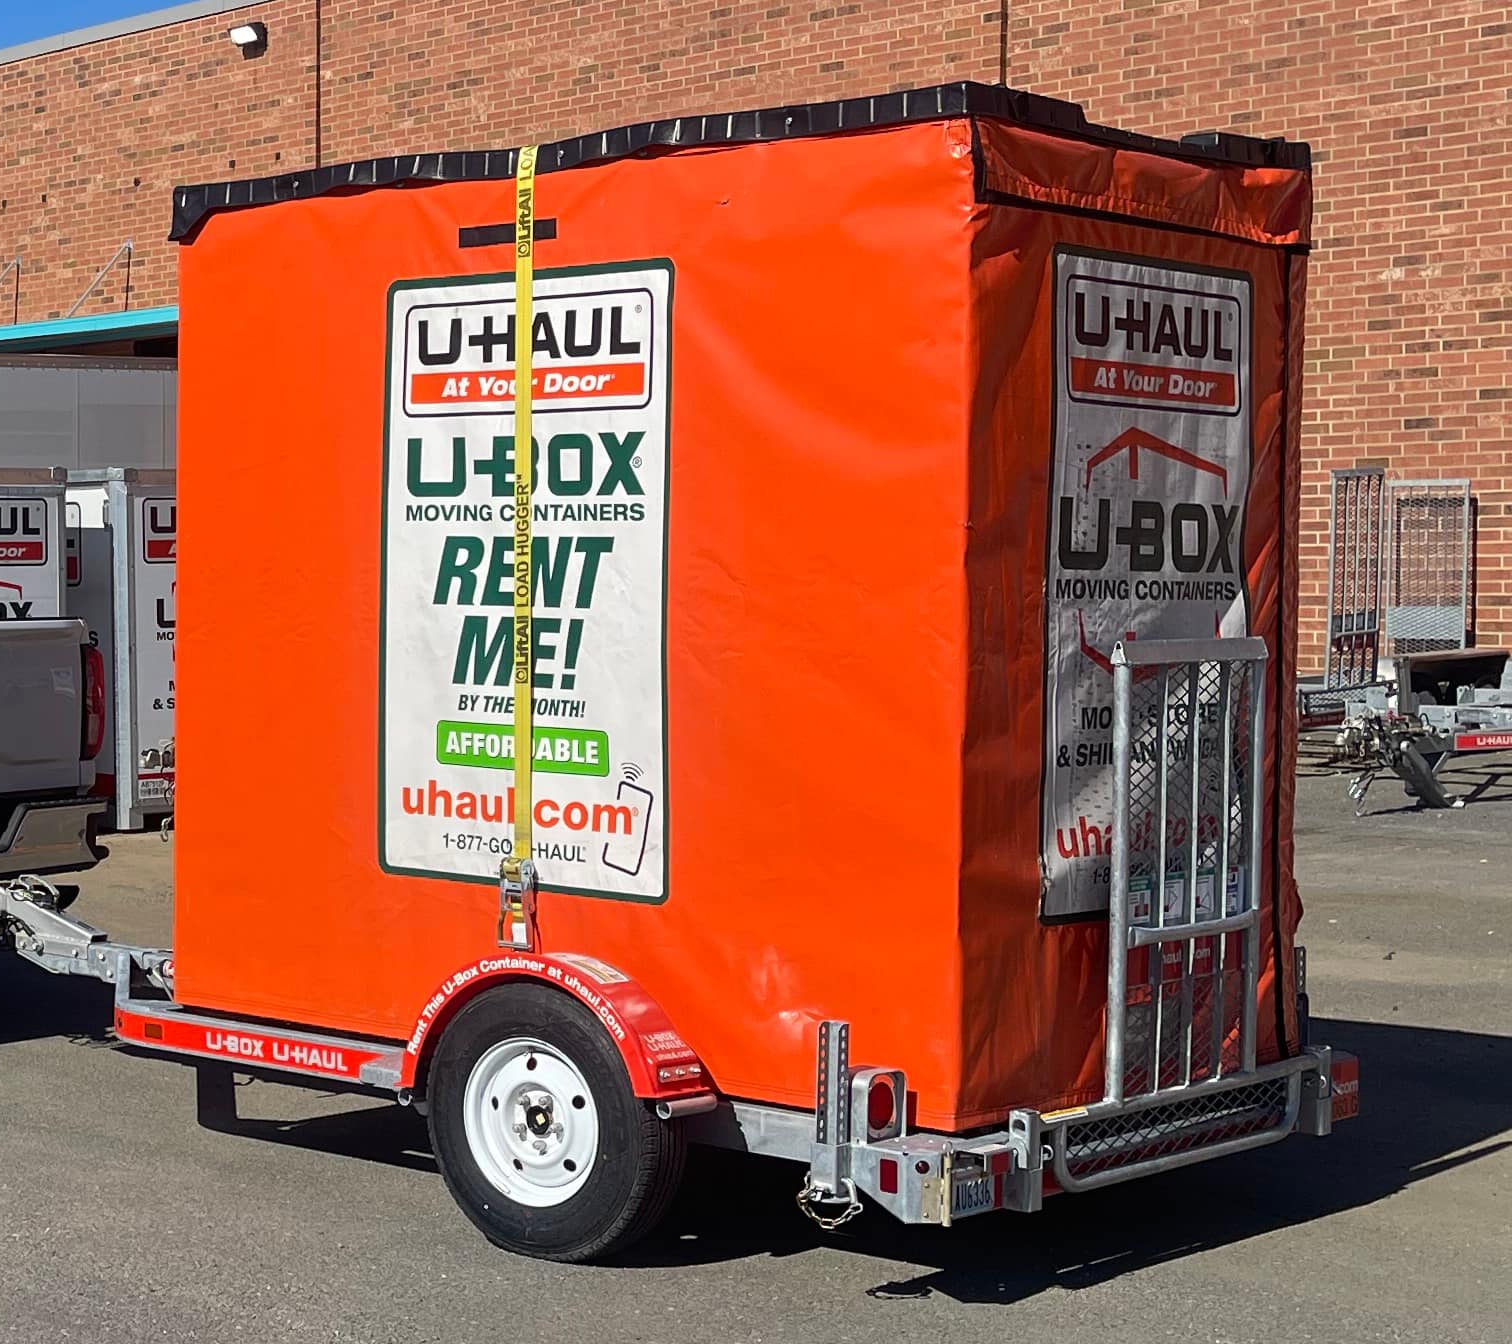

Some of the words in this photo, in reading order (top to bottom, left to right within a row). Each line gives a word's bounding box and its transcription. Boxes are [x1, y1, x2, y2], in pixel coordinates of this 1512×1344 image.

[418, 306, 641, 366] U-HAUL
[1075, 292, 1232, 362] U-HAUL
[442, 377, 470, 397] At
[544, 373, 610, 394] Door
[1094, 367, 1117, 389] At
[1123, 369, 1164, 393] Your
[1168, 375, 1215, 398] Door
[406, 431, 647, 497] U-BOX
[405, 505, 493, 522] MOVING
[500, 503, 645, 522] CNTAINERS
[1058, 496, 1240, 573] U-BOX
[432, 535, 615, 609] RENT
[516, 561, 529, 607] LOAD
[1055, 578, 1129, 600] MOVING
[1135, 580, 1236, 601] CONTAINERS
[452, 615, 584, 690] ME!
[458, 695, 481, 712] BY
[483, 696, 516, 714] THE
[445, 731, 600, 765] AFFORABLE
[402, 780, 633, 835] uhaulcom
[442, 833, 586, 863] 1-877-GO-HAUL
[406, 1018, 428, 1055] Rent
[422, 993, 444, 1019] This
[442, 966, 479, 995] U-Box
[480, 956, 545, 972] Container
[547, 964, 563, 979] at
[564, 973, 626, 1041] uhaul.com
[206, 1031, 265, 1058] U-BOX
[272, 1041, 348, 1072] U-HAUL
